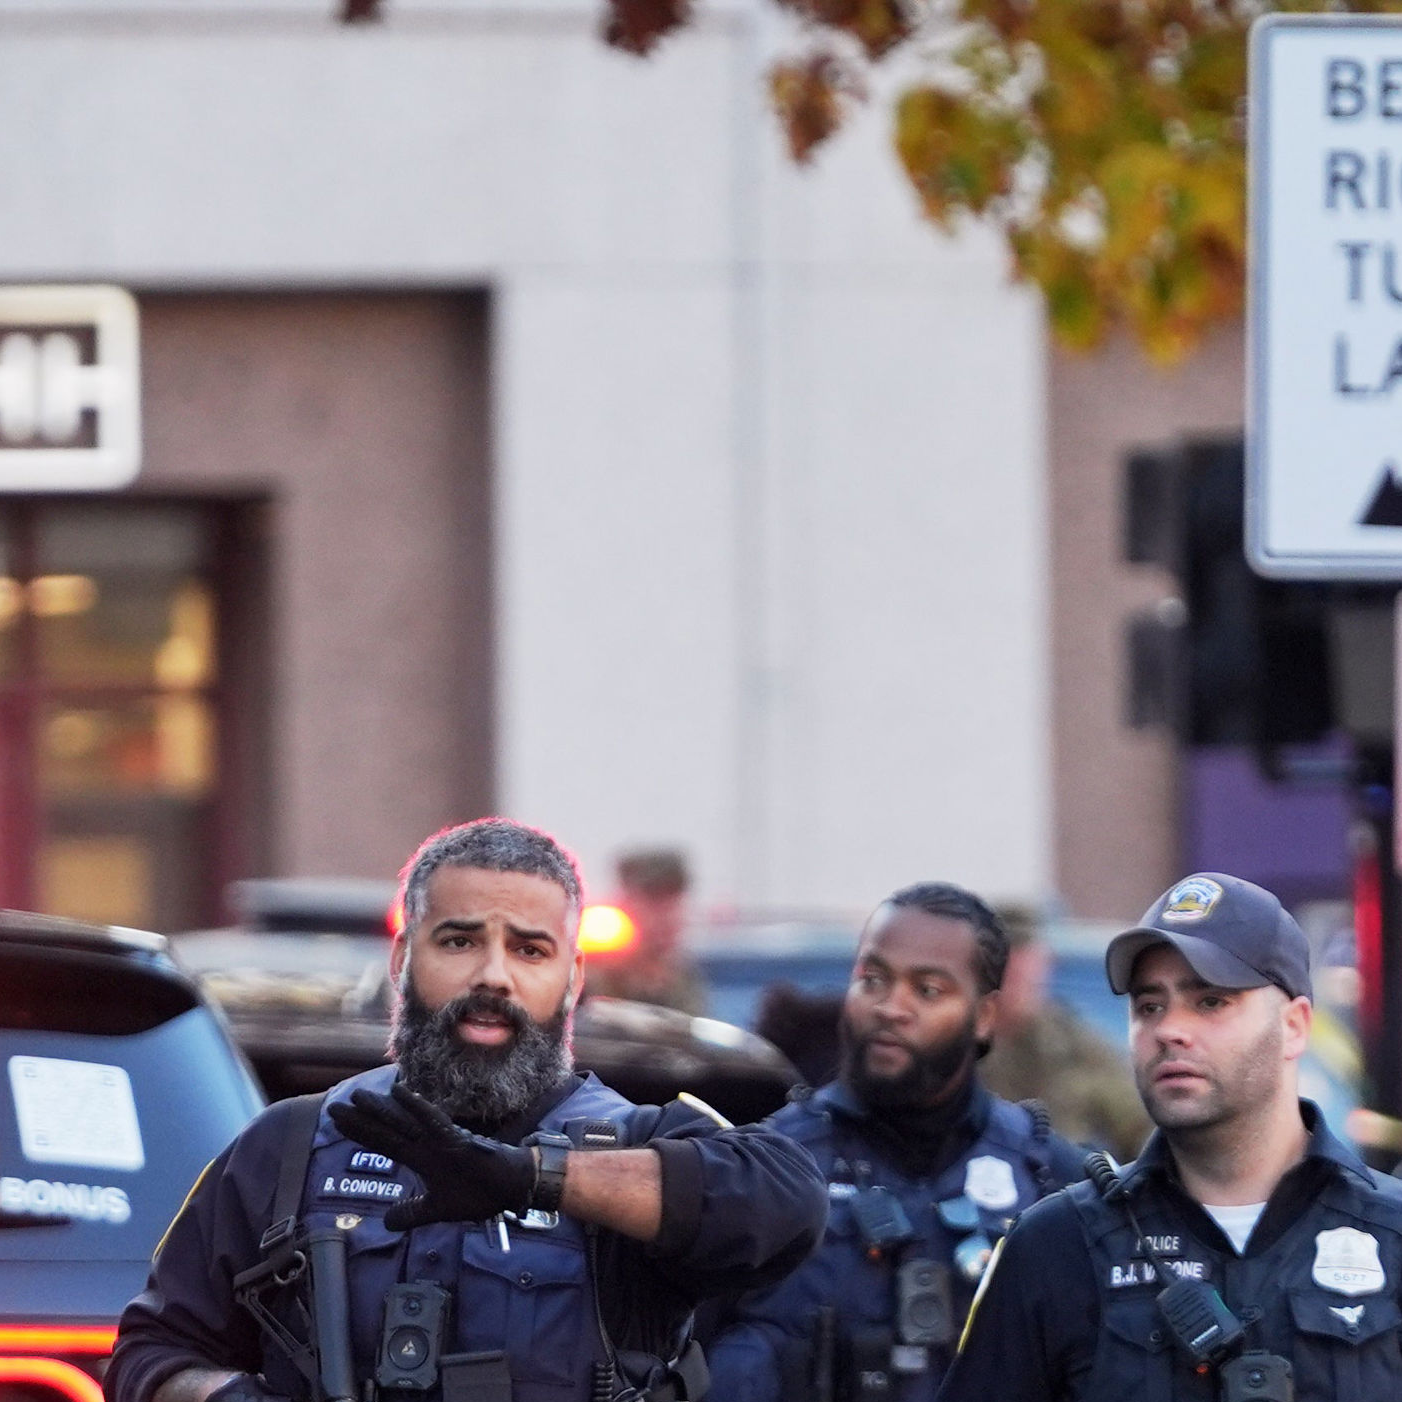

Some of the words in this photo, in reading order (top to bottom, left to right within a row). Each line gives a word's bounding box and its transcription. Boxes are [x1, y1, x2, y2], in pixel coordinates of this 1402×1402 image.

[324, 1177, 336, 1192] B.
[340, 1177, 403, 1197] CONOVER
[0, 1176, 132, 1224] BONUS
[1143, 1261, 1203, 1281] VONE
